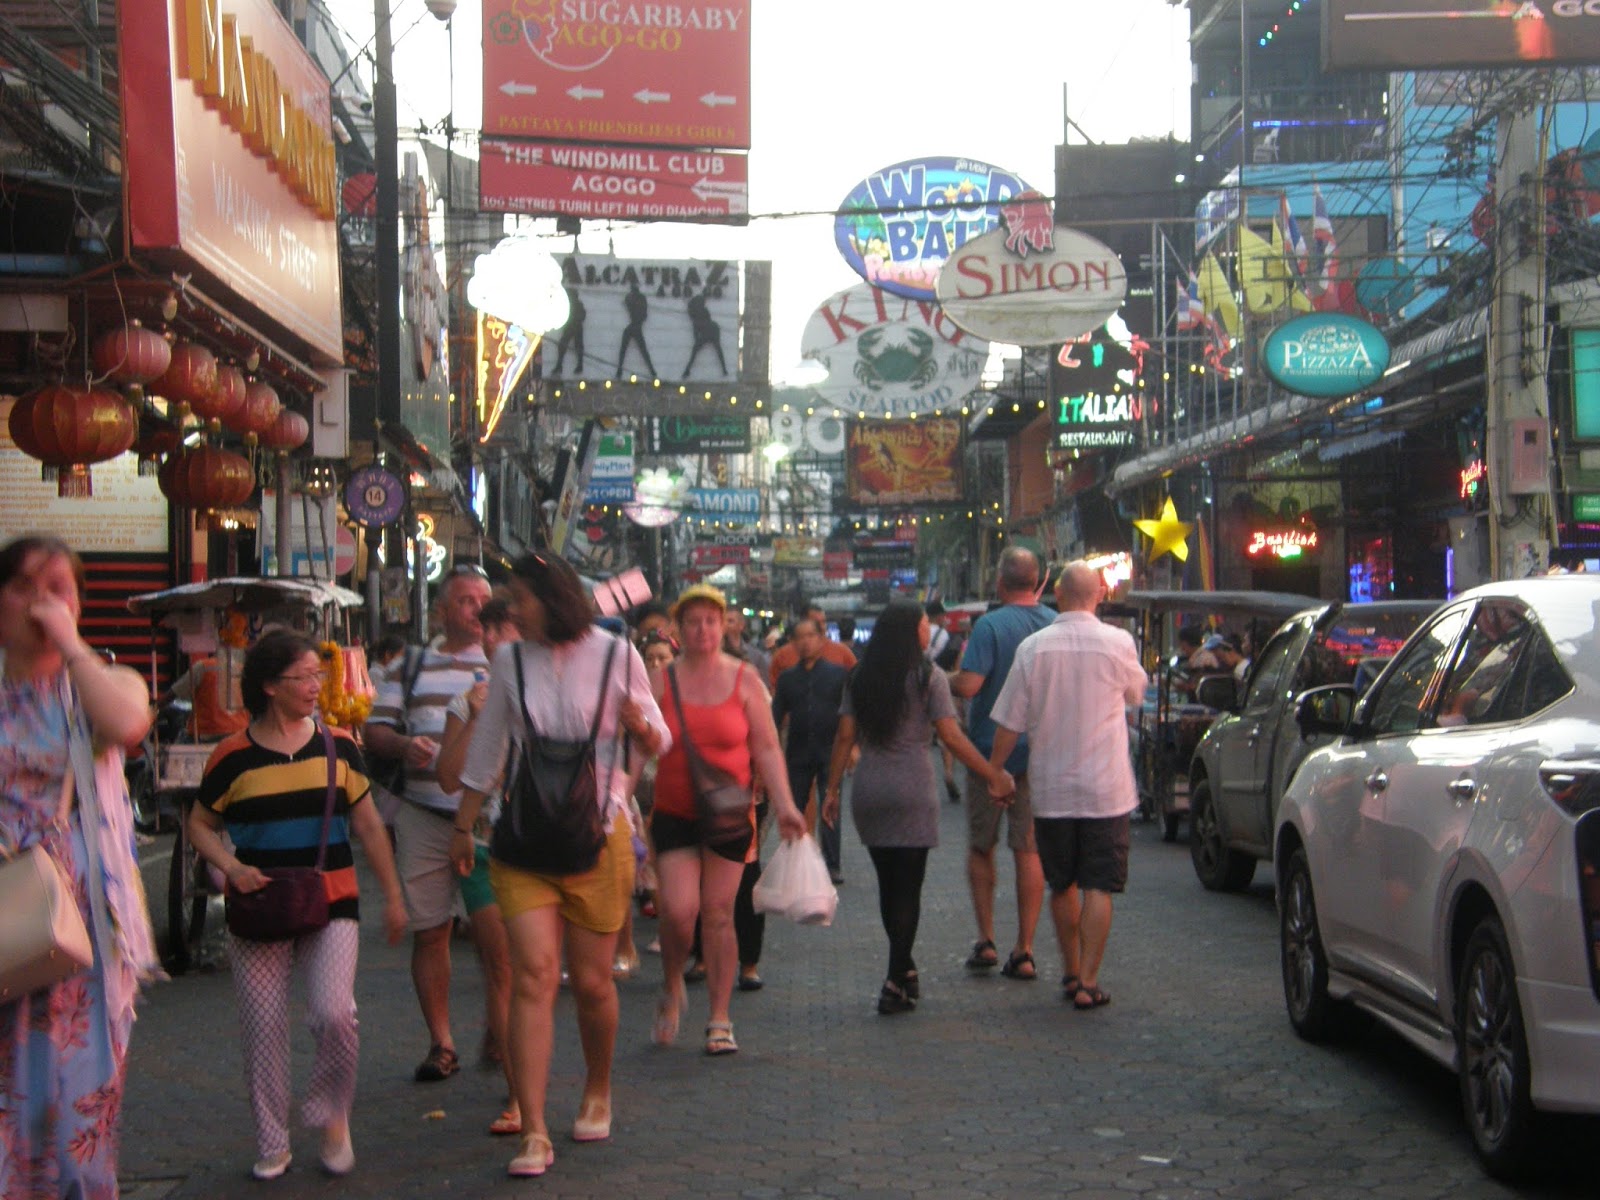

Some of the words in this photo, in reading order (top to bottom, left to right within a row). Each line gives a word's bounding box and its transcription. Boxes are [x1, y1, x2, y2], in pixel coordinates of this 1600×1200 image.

[561, 0, 743, 31] SUGARBABY
[556, 23, 682, 51] AGO-GO
[499, 116, 574, 132] PATTAYA
[687, 126, 736, 140] GIRLS
[503, 146, 543, 165] THE
[551, 151, 660, 172] WINDMILL
[668, 156, 725, 175] CLUB
[571, 175, 656, 196] AGOGO
[508, 198, 556, 212] METRES
[559, 200, 592, 214] TURN
[594, 202, 623, 215] LEFT
[627, 204, 639, 215] IN
[642, 204, 663, 217] SOI
[667, 206, 726, 217] DIAMOND
[279, 224, 318, 293] STREET
[562, 257, 729, 285] ALCATRAZ
[955, 254, 1112, 300] SIMON
[1059, 394, 1142, 423] ITALIAN
[369, 490, 381, 502] 14
